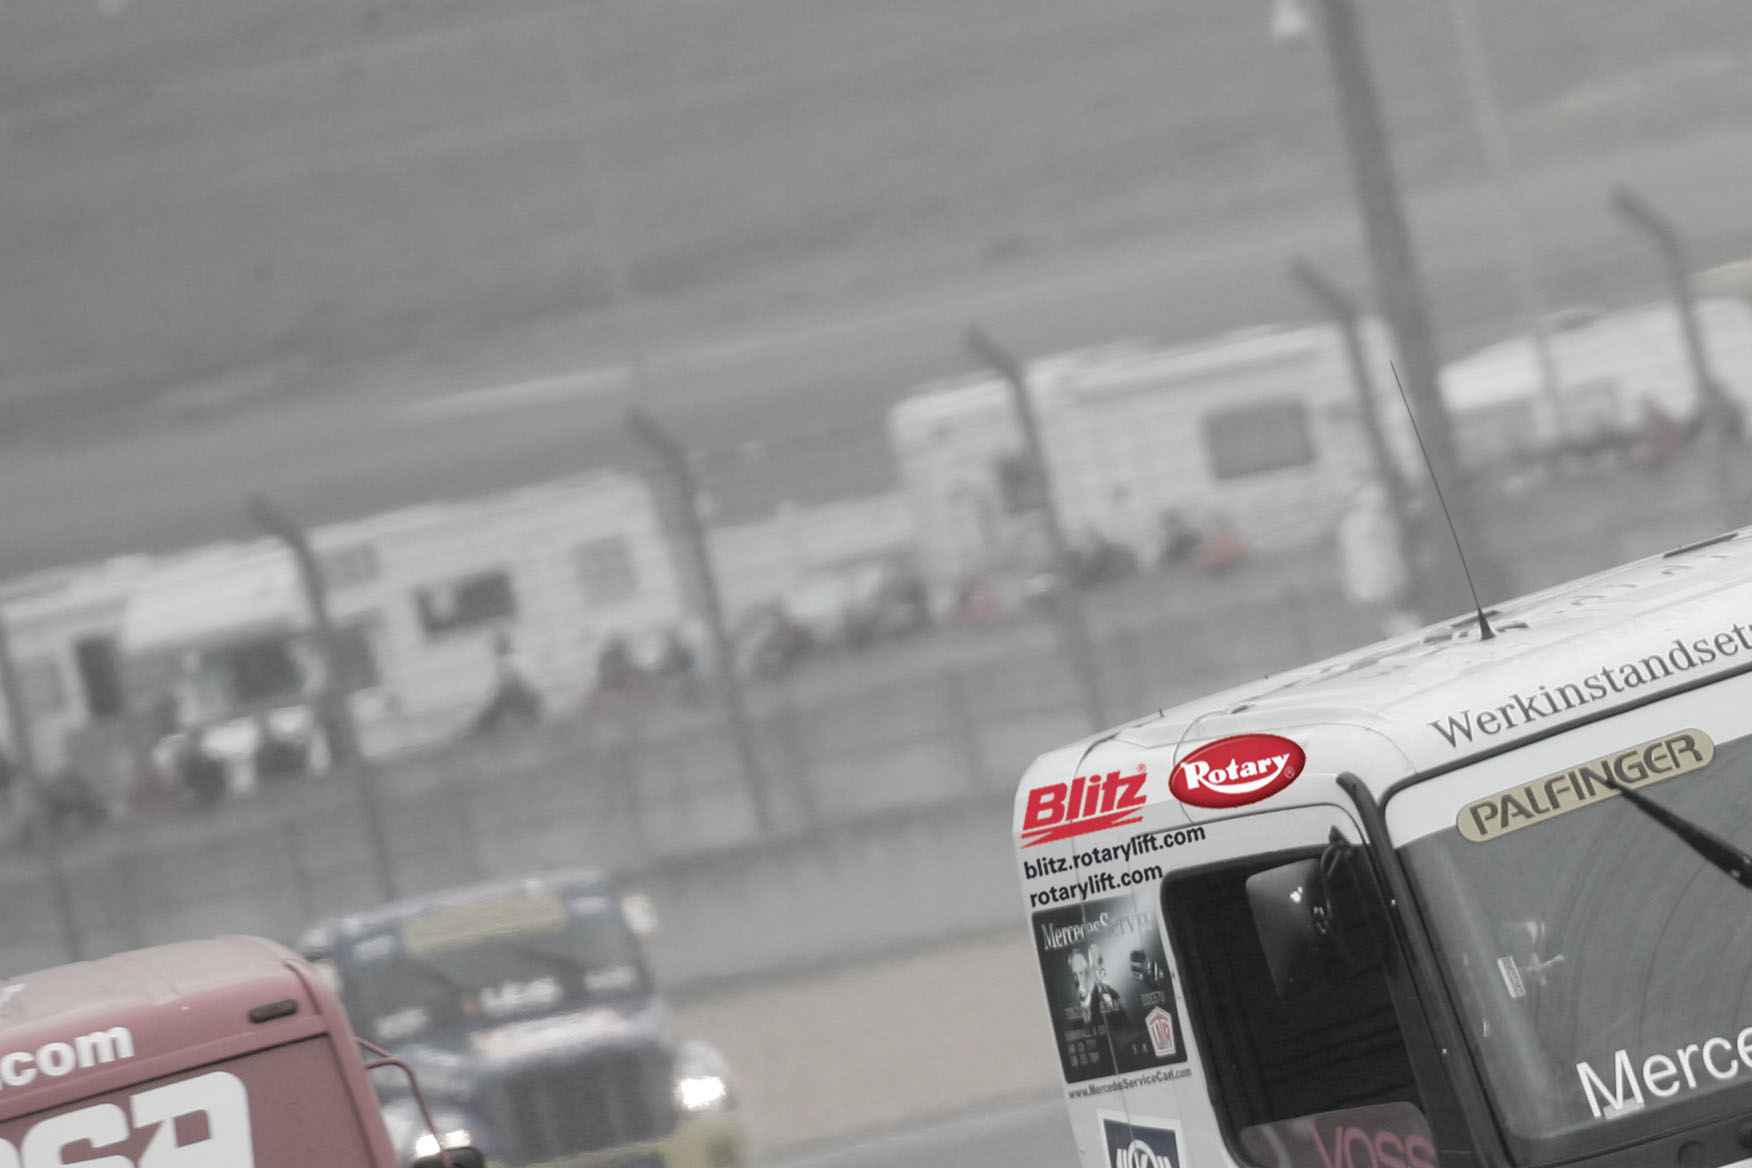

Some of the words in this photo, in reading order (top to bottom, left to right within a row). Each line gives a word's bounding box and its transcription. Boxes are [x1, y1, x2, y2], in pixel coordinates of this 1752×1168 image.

[1022, 769, 1148, 831] Blitz
[1180, 752, 1291, 794] Rotary
[1469, 732, 1704, 836] PALFINGER
[1024, 825, 1207, 880] blitz.rotarylift.com
[1029, 863, 1164, 908] rotarylift.com
